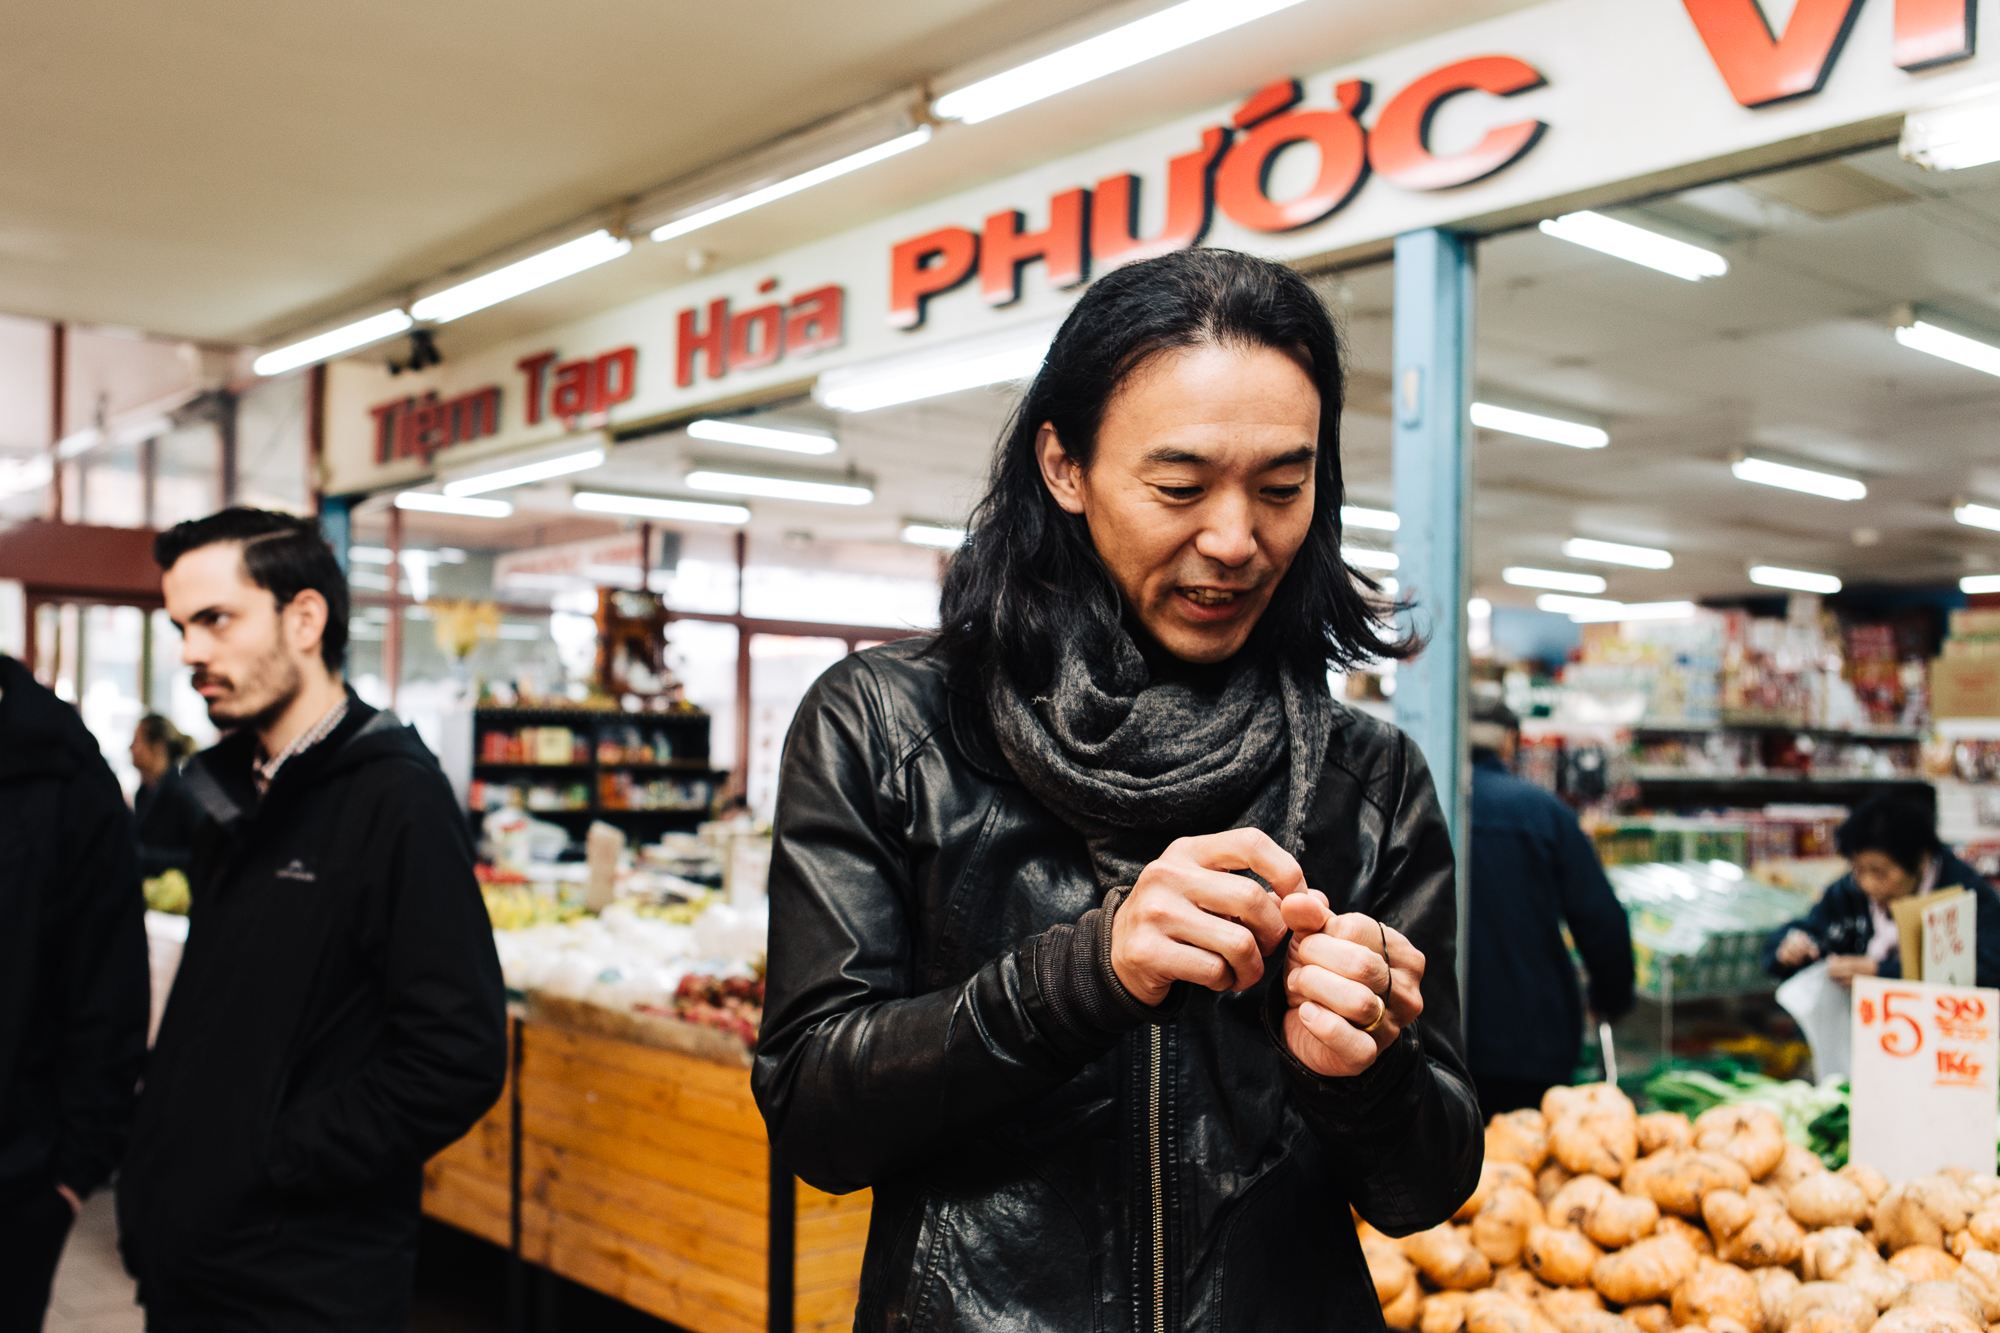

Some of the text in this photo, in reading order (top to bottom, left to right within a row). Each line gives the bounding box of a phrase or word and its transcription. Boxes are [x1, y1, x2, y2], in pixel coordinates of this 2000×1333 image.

[371, 384, 502, 468] Tiệm
[517, 346, 637, 430] Tạp
[888, 54, 1546, 328] PHƯỚC
